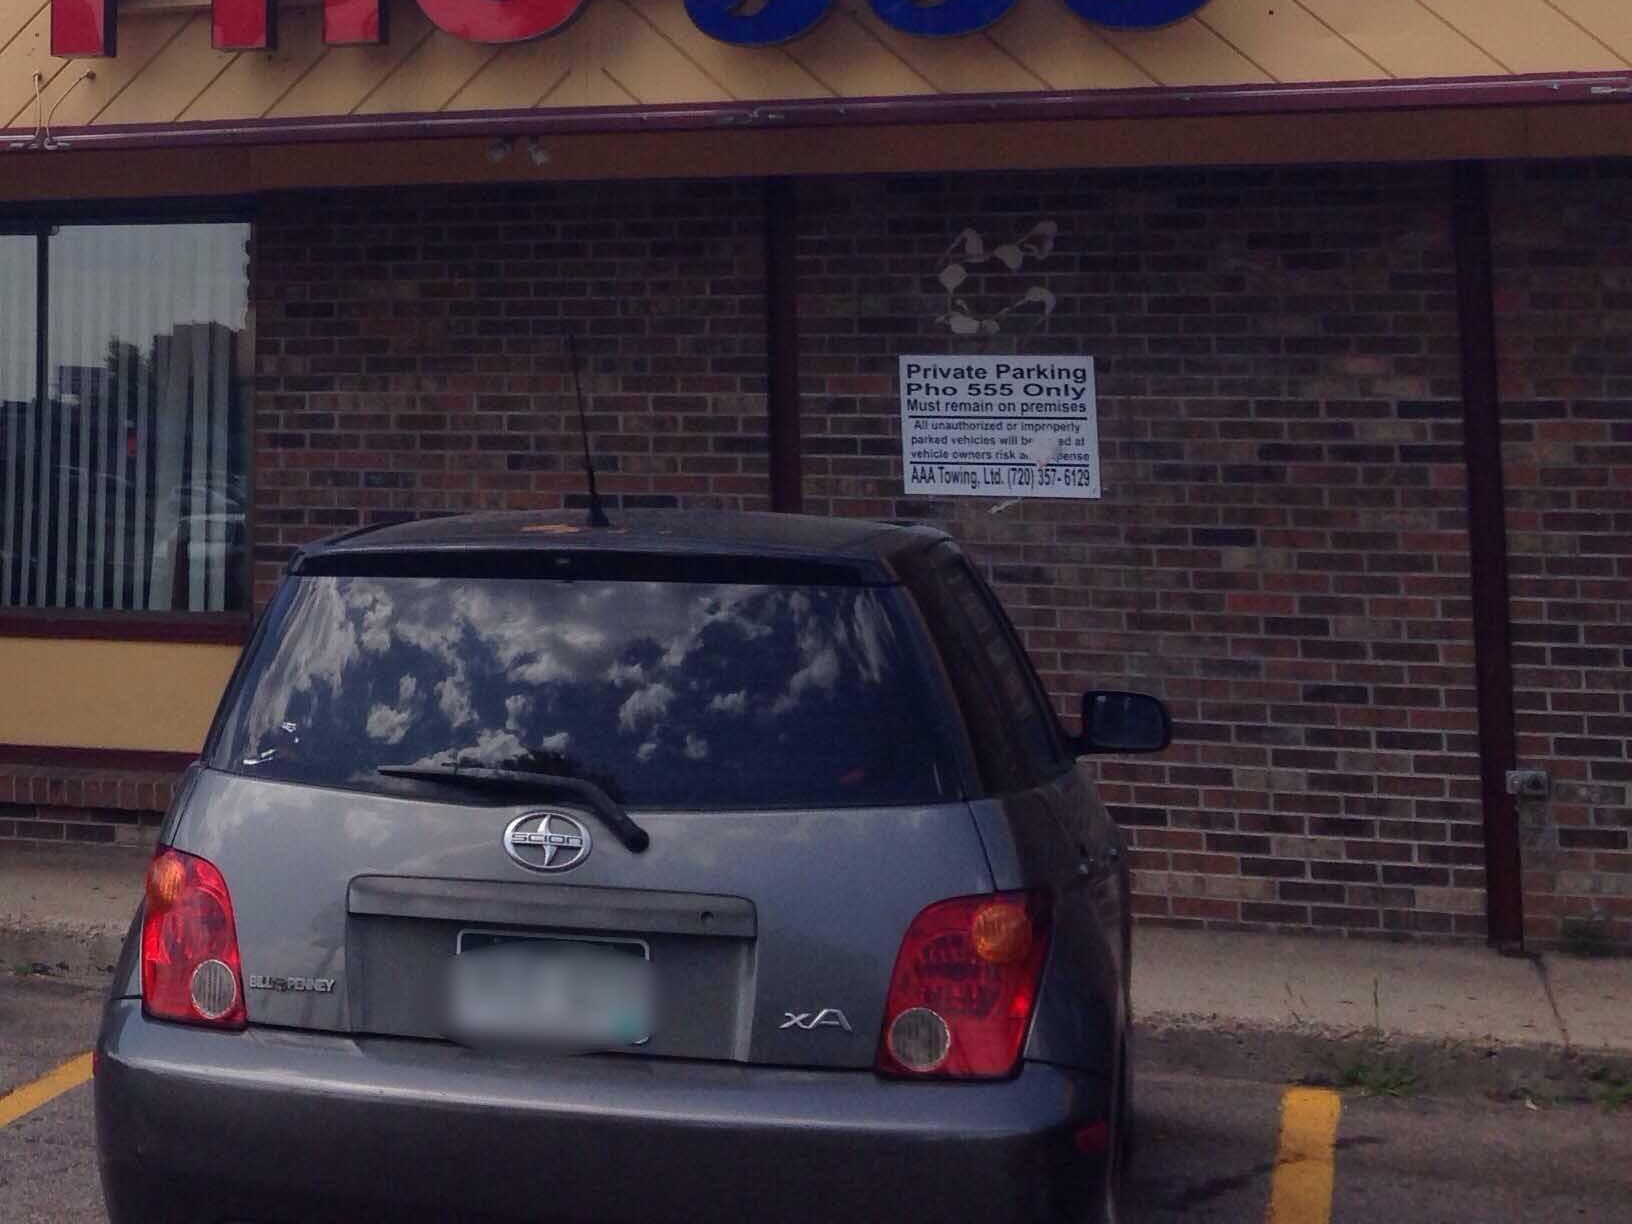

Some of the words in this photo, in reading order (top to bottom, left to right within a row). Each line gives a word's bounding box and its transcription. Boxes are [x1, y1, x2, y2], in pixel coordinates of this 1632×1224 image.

[906, 363, 987, 380] Private
[995, 364, 1087, 383] Parking
[906, 383, 958, 396] Pho
[968, 383, 1014, 397] 555
[1023, 383, 1086, 400] Only
[906, 399, 940, 412] Must
[945, 400, 993, 412] remain
[998, 402, 1016, 412] on
[1020, 401, 1087, 416] premises
[914, 421, 929, 430] All
[931, 420, 1003, 431] unauthorized
[1006, 423, 1018, 431] or
[1020, 422, 1081, 434] improperly
[911, 436, 948, 447] parked
[951, 436, 996, 446] vehicles
[999, 436, 1018, 446] will
[911, 450, 949, 460] vehicle
[952, 452, 992, 461] owners
[995, 450, 1016, 461] risk
[911, 466, 936, 484] AAA
[939, 466, 980, 489] Towing,
[984, 467, 1004, 486] Ltd.
[1007, 467, 1034, 489] (720)
